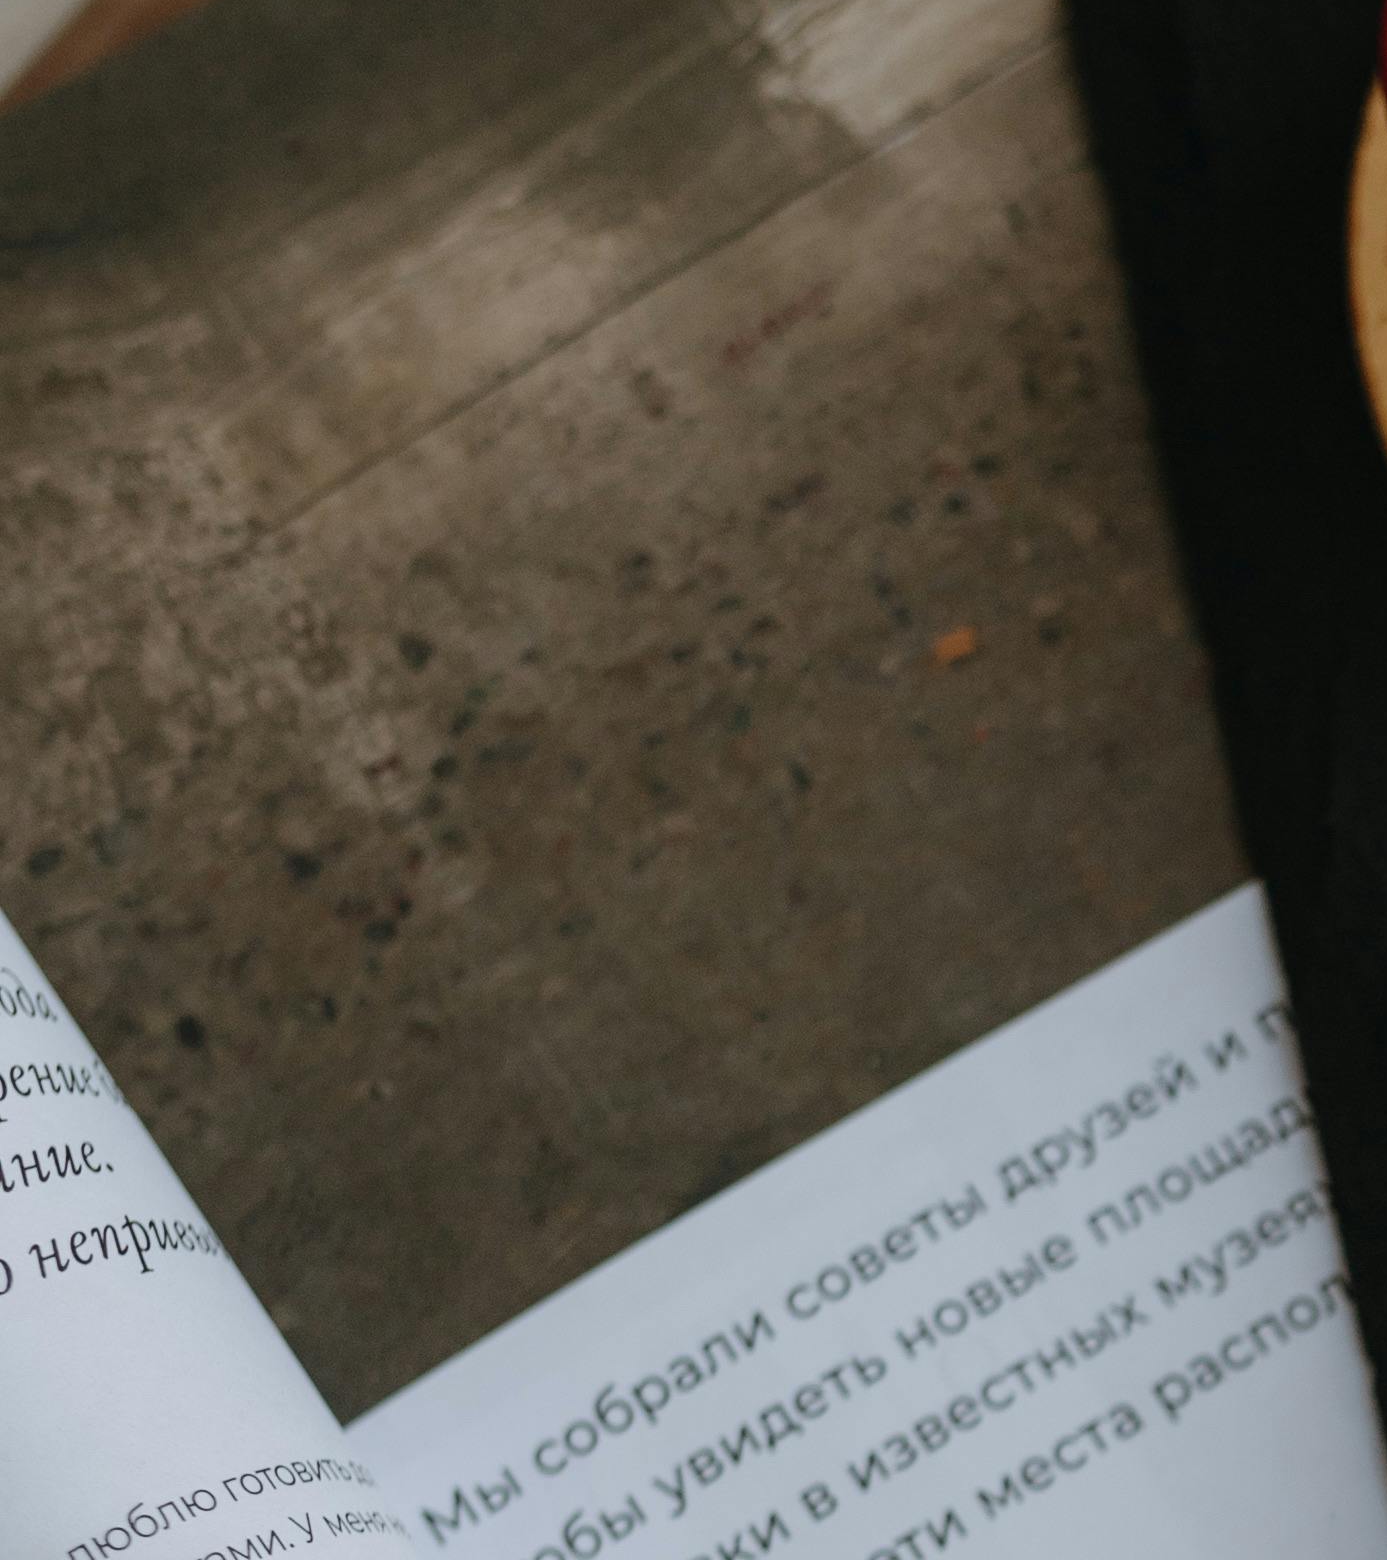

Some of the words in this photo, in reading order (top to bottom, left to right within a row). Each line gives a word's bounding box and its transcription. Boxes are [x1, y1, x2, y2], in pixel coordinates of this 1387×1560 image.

[422, 1463, 524, 1547] Мы
[533, 1309, 775, 1482] собрали
[785, 1182, 987, 1323] советы
[996, 1051, 1197, 1207] друзей
[1204, 1029, 1248, 1072] и
[653, 1348, 889, 1521] увидеть
[897, 1230, 1079, 1362] новые
[800, 1478, 840, 1524] в
[850, 1295, 1150, 1494] известных
[1155, 1180, 1331, 1309] музея
[223, 1459, 351, 1501] готовить
[288, 1512, 313, 1543] У
[977, 1402, 1145, 1523] места
